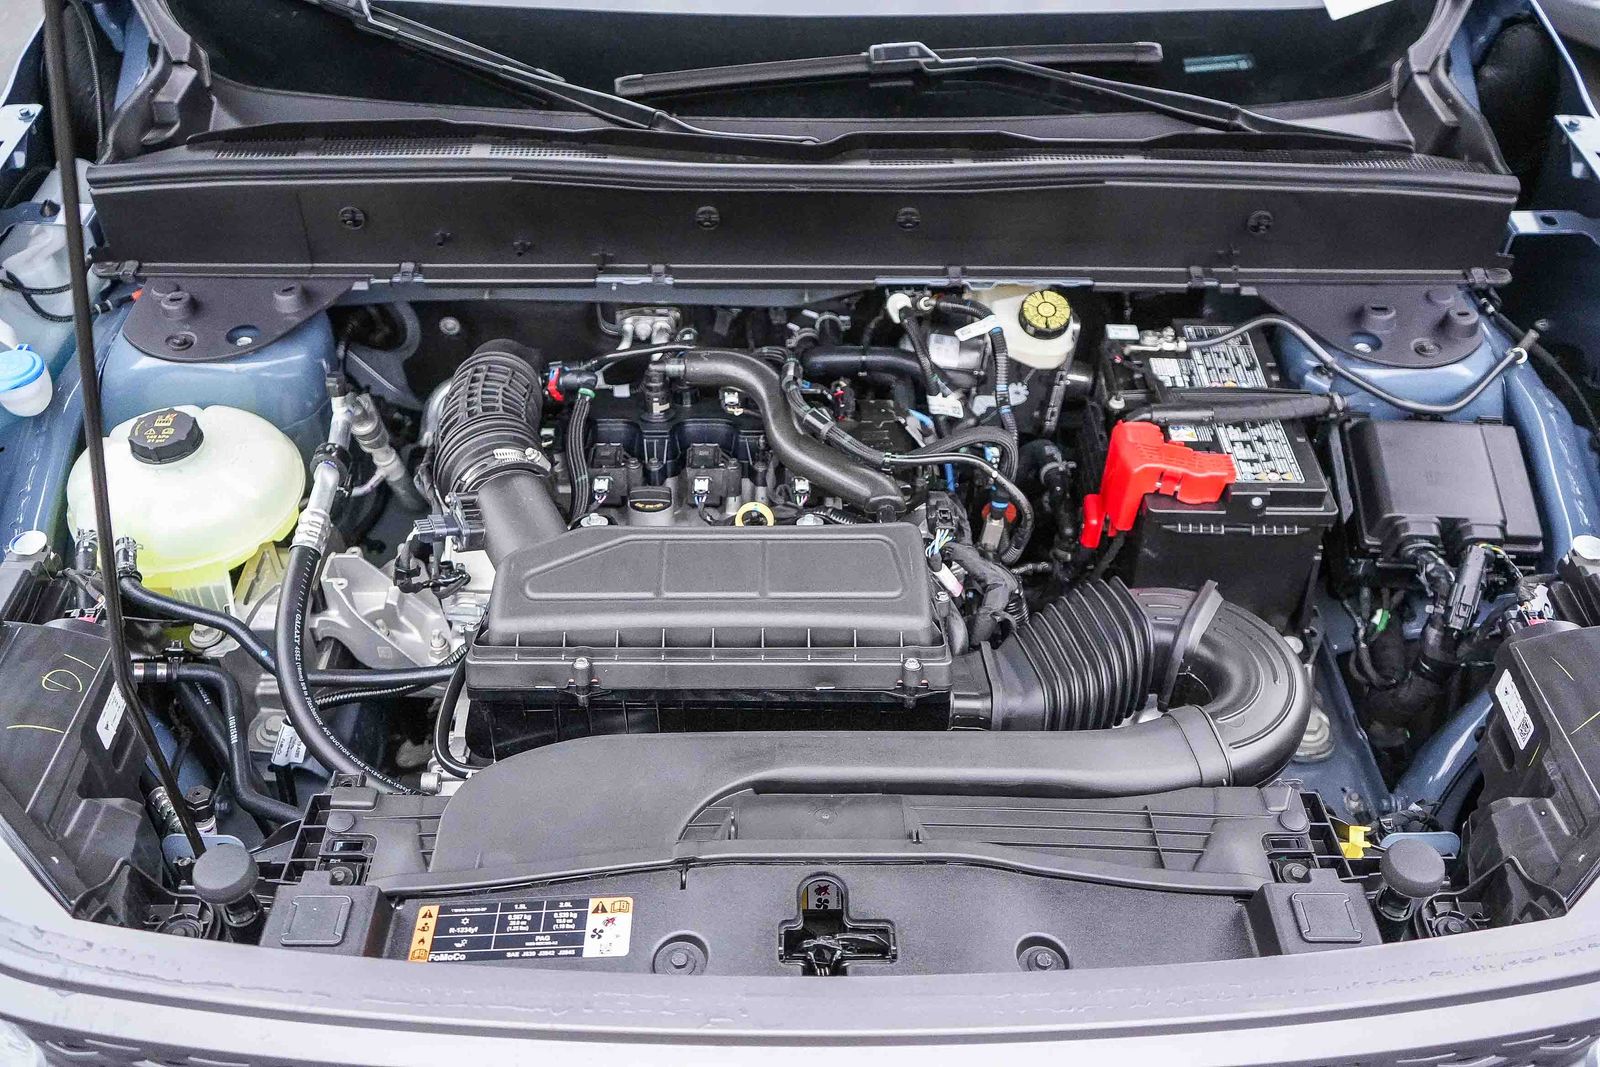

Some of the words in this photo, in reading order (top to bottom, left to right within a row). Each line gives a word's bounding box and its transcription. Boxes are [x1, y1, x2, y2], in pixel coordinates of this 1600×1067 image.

[294, 613, 302, 645] GALAXY
[305, 696, 324, 727] Flexbarrier
[322, 726, 331, 737] A/C
[328, 734, 351, 757] SUCTION
[349, 754, 366, 767] HOSE
[449, 926, 479, 934] R-1234yf
[428, 953, 466, 962] FoMoCo
